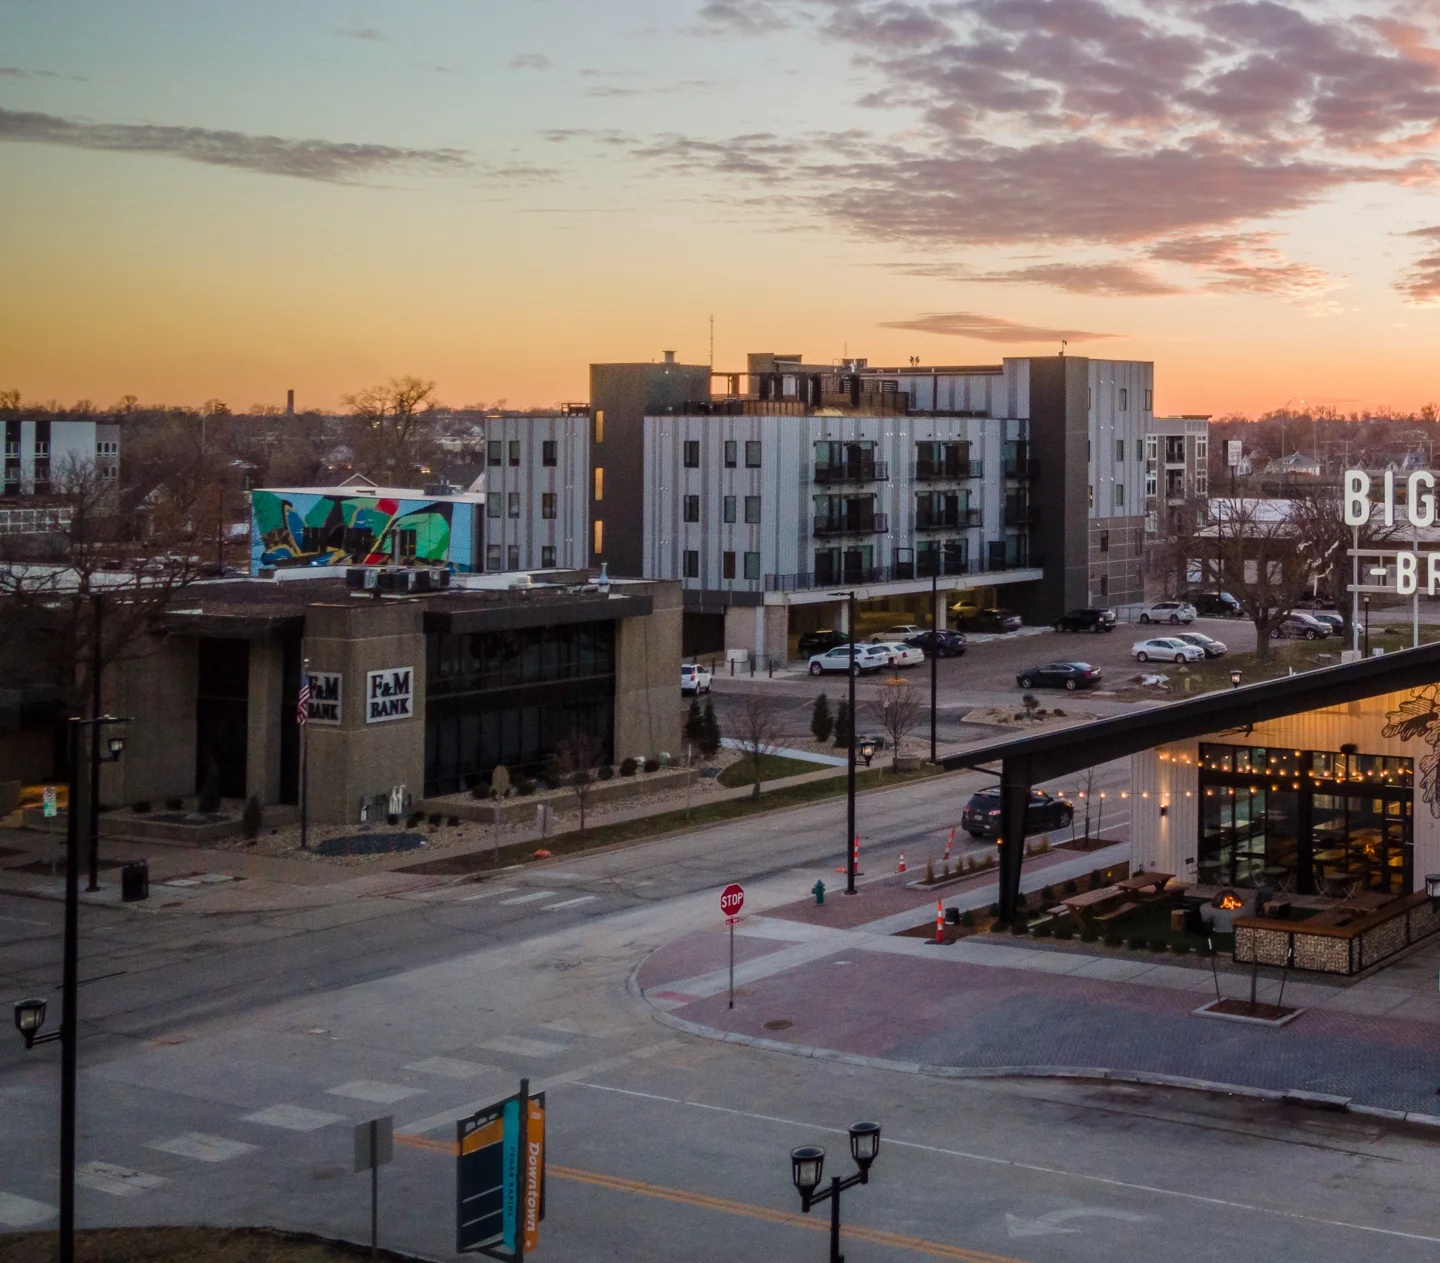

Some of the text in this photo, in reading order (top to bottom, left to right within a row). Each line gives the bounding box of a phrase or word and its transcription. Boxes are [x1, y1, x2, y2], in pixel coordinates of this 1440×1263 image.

[1344, 470, 1435, 527] BIG
[308, 675, 339, 700] F&M
[371, 671, 411, 698] F&M
[371, 698, 410, 719] BANK
[721, 892, 743, 909] STOP
[507, 1146, 516, 1217] CEDAR RAPIDS
[527, 1142, 540, 1232] Downtown
